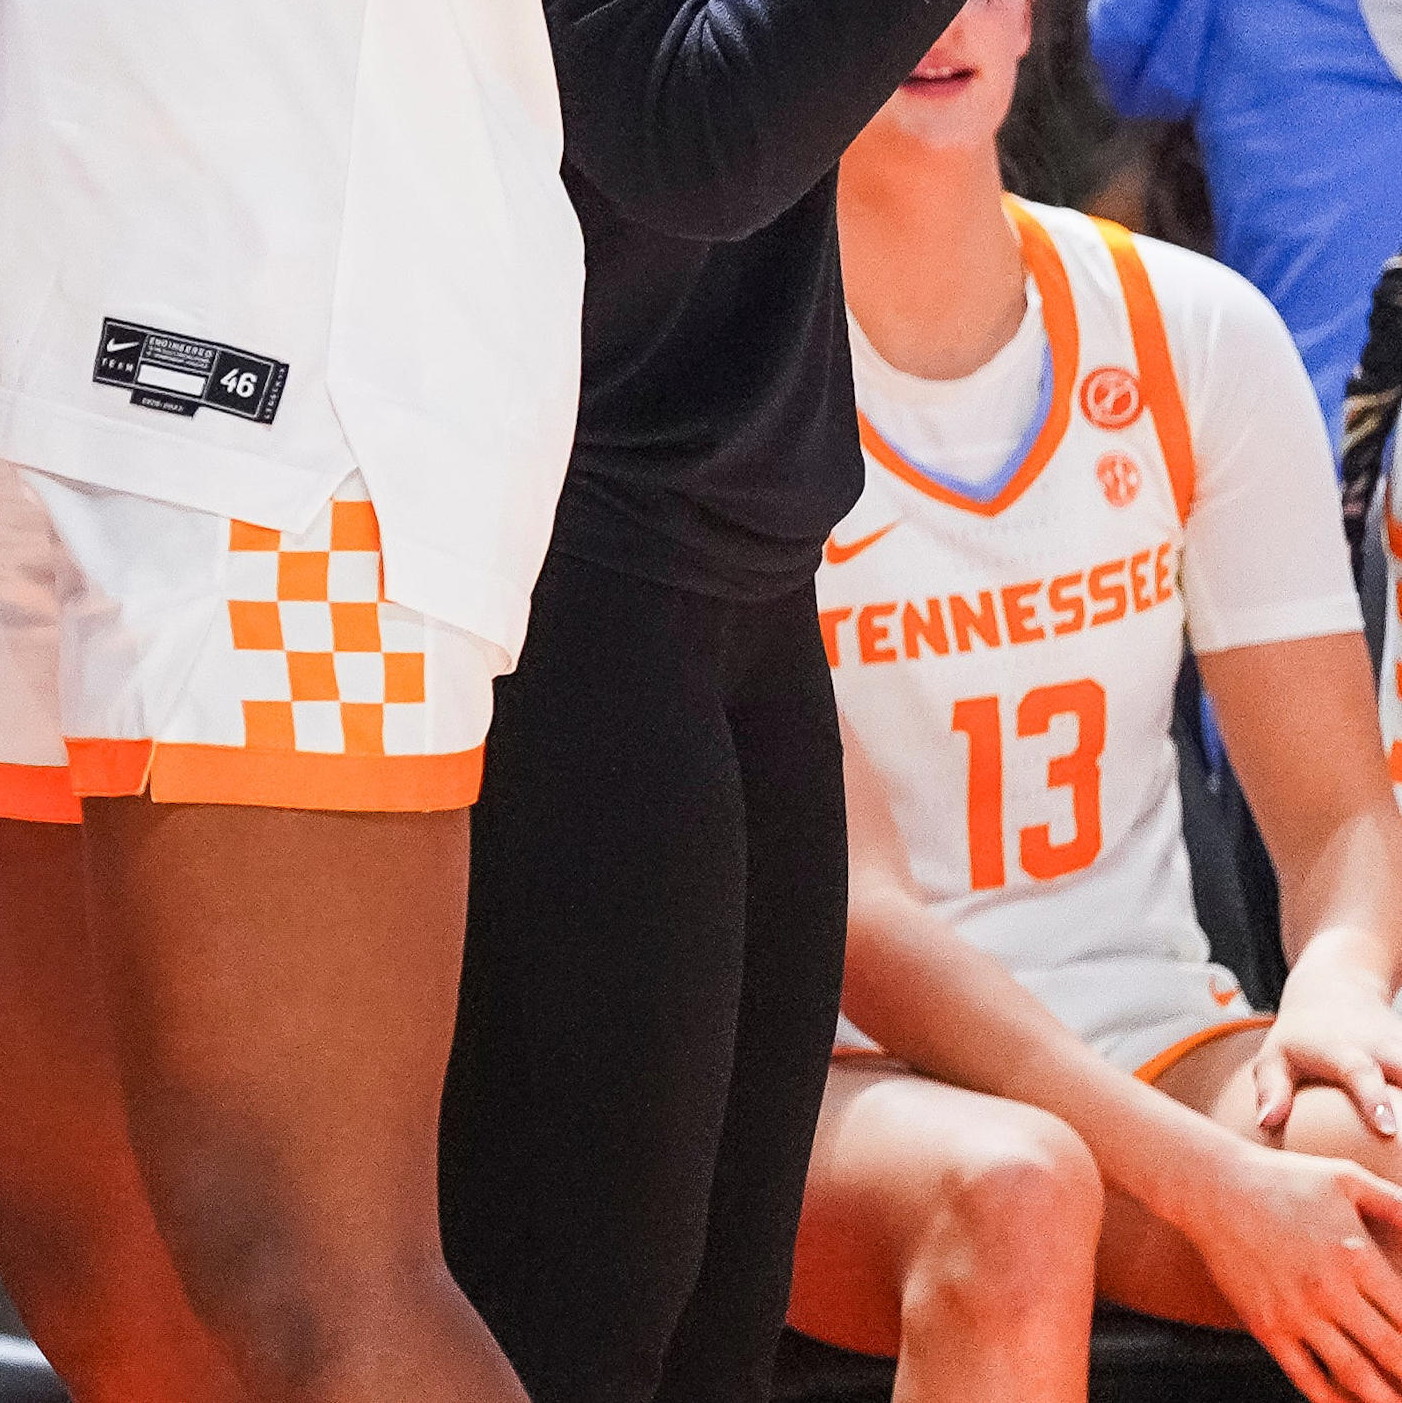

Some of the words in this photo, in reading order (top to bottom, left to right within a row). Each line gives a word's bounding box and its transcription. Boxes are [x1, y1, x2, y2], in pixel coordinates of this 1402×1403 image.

[101, 357, 135, 373] TEAM
[219, 367, 258, 398] 46
[818, 542, 1175, 669] TENNESSEE
[951, 677, 1107, 891] 13
